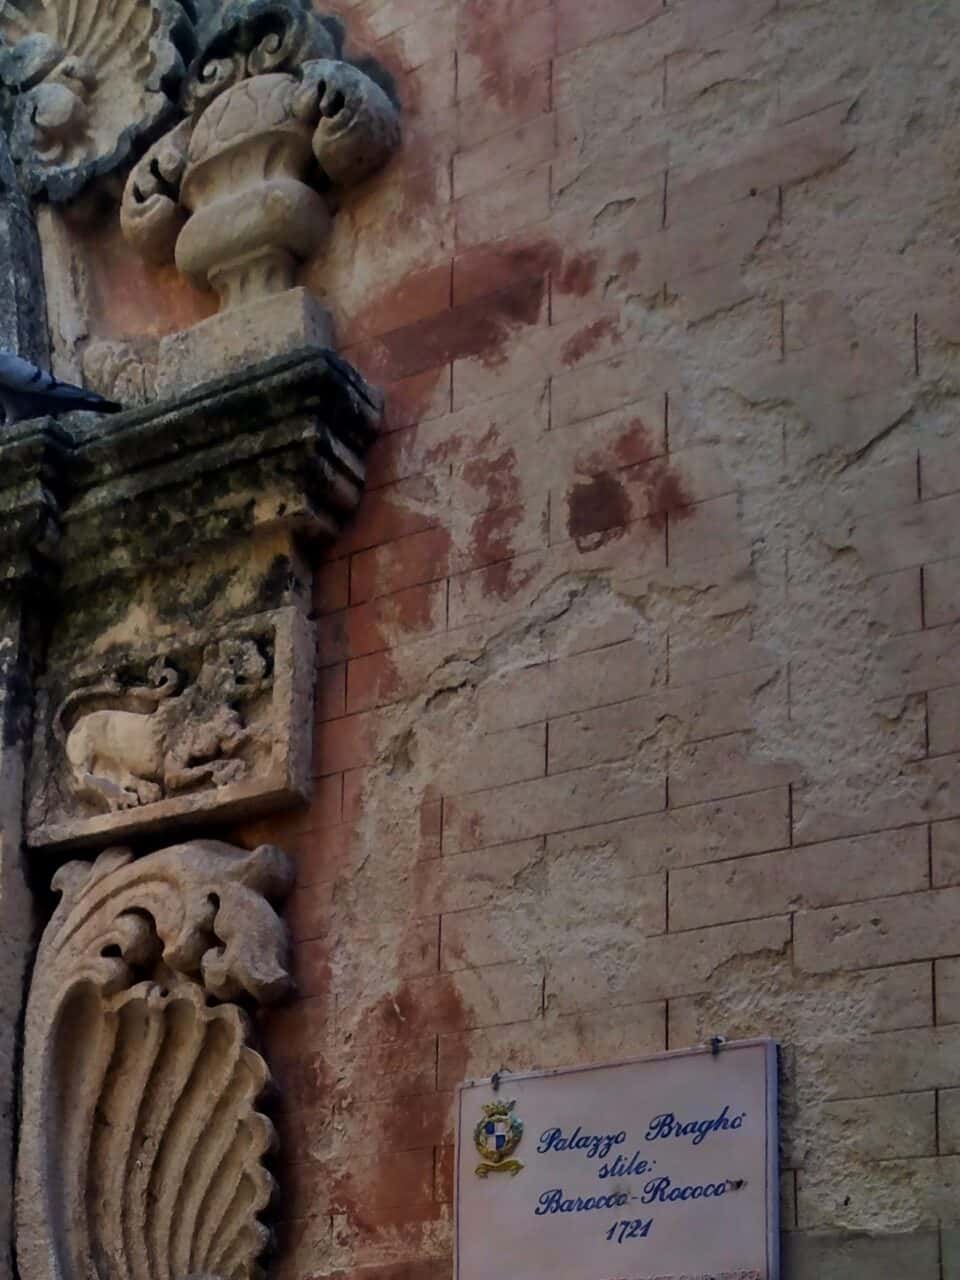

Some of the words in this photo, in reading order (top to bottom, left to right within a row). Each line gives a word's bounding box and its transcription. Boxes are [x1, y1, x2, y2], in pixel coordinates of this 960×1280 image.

[537, 1126, 627, 1159] Palazzo
[598, 1150, 657, 1179] stile:
[606, 1218, 653, 1244] 1721
